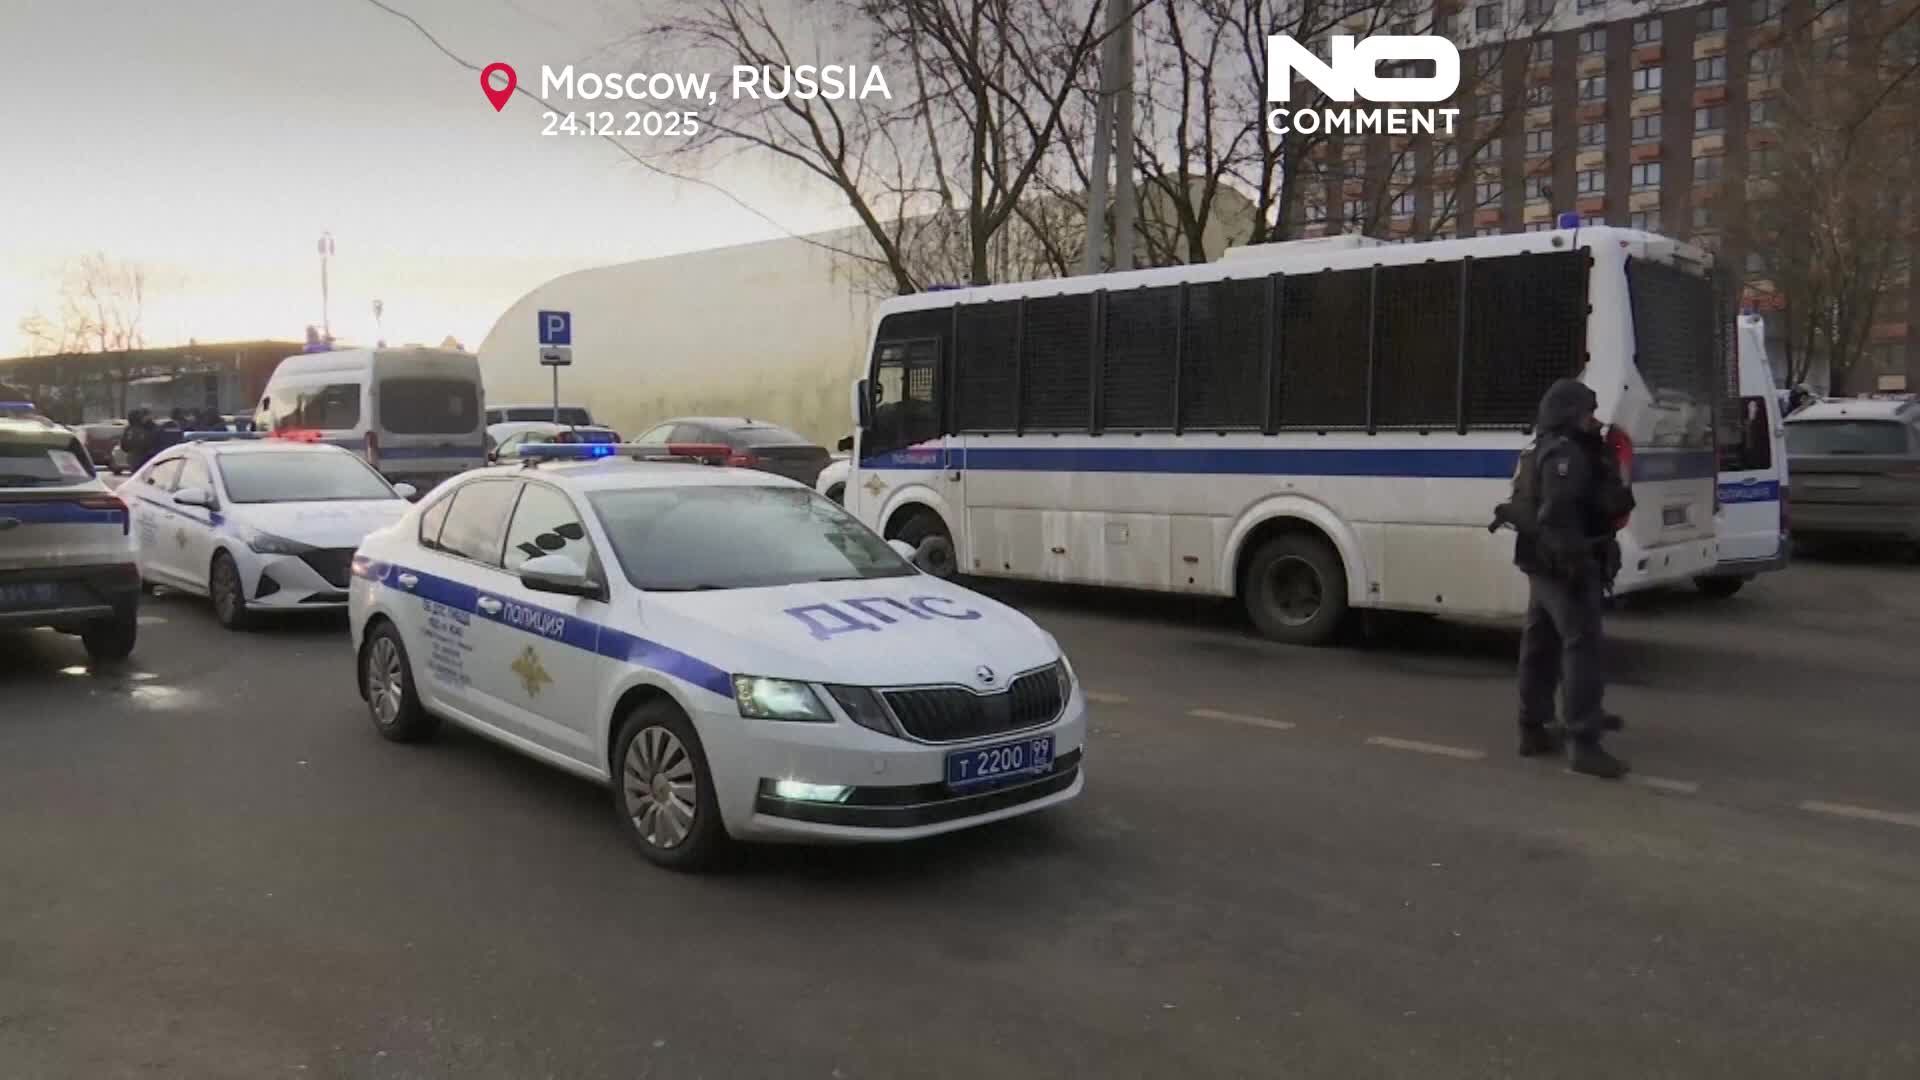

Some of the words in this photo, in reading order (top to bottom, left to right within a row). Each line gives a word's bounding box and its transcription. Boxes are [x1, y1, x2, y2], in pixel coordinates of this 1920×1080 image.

[547, 315, 565, 341] P
[503, 603, 565, 638] ПОЛИЦИЯ
[783, 595, 983, 641] ДПС
[976, 746, 1023, 775] 2200
[1033, 739, 1048, 757] 99
